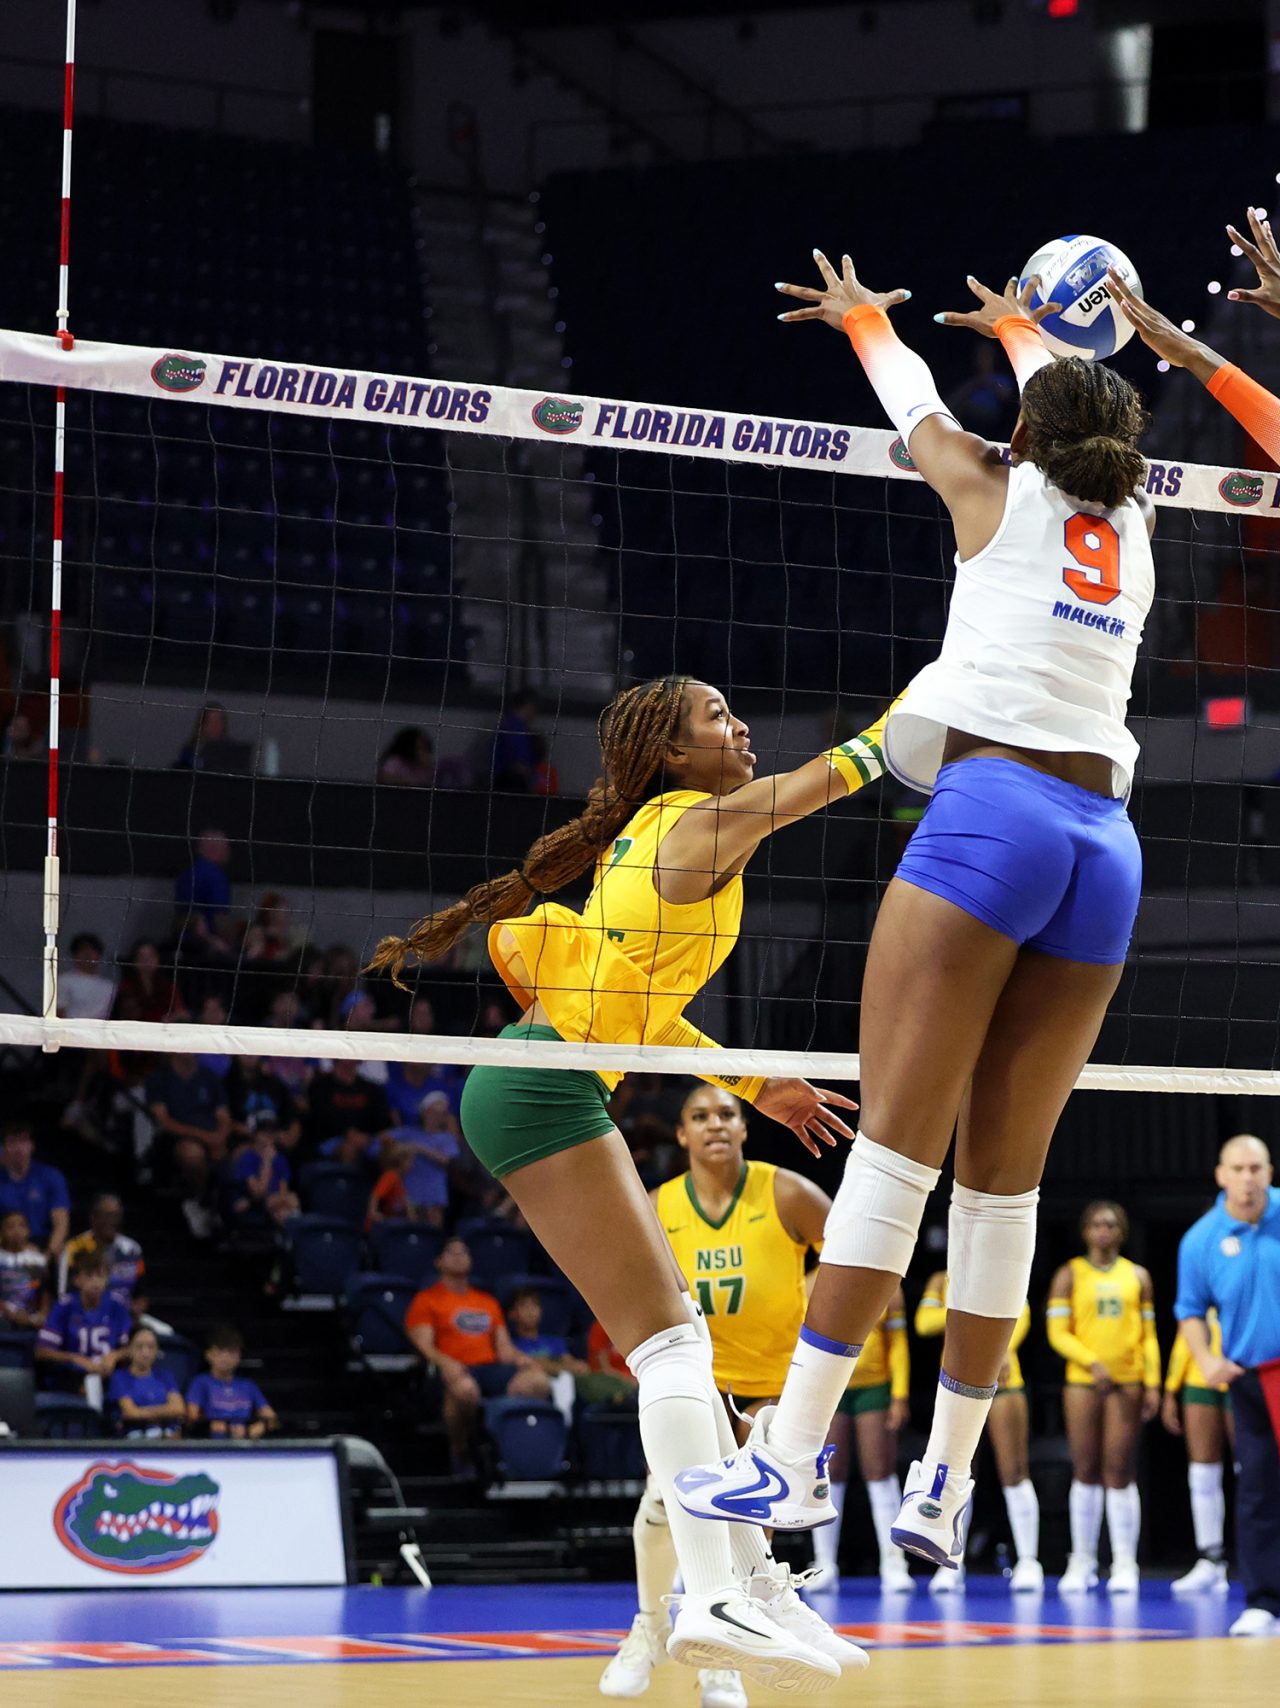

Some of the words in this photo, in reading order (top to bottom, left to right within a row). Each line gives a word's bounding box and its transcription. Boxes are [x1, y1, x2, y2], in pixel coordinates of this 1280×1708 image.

[1078, 264, 1130, 314] mten
[213, 360, 358, 409] FLORIDA
[363, 378, 492, 424] GATORS
[592, 403, 726, 450] FLORIDA
[731, 420, 851, 462] GATORS
[1063, 511, 1121, 606] 9
[696, 1245, 743, 1271] NSU
[695, 1275, 745, 1317] 17
